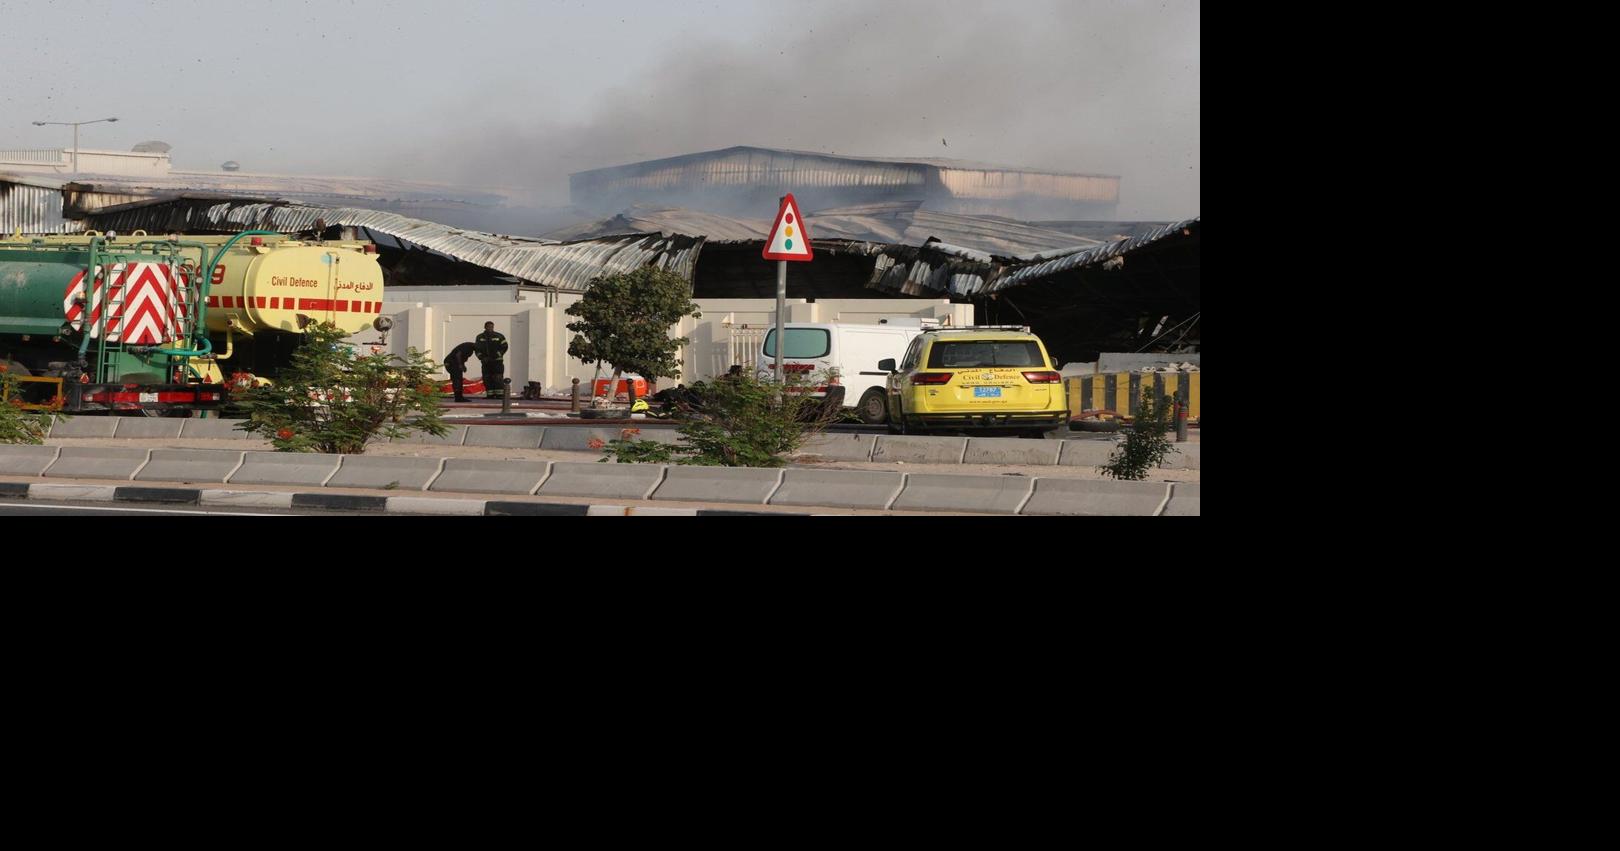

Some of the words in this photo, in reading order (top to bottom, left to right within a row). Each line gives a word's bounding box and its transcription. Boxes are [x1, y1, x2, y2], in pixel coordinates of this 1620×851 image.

[271, 276, 288, 287] Civil
[289, 277, 318, 288] Defence
[354, 282, 374, 294] الدفاع
